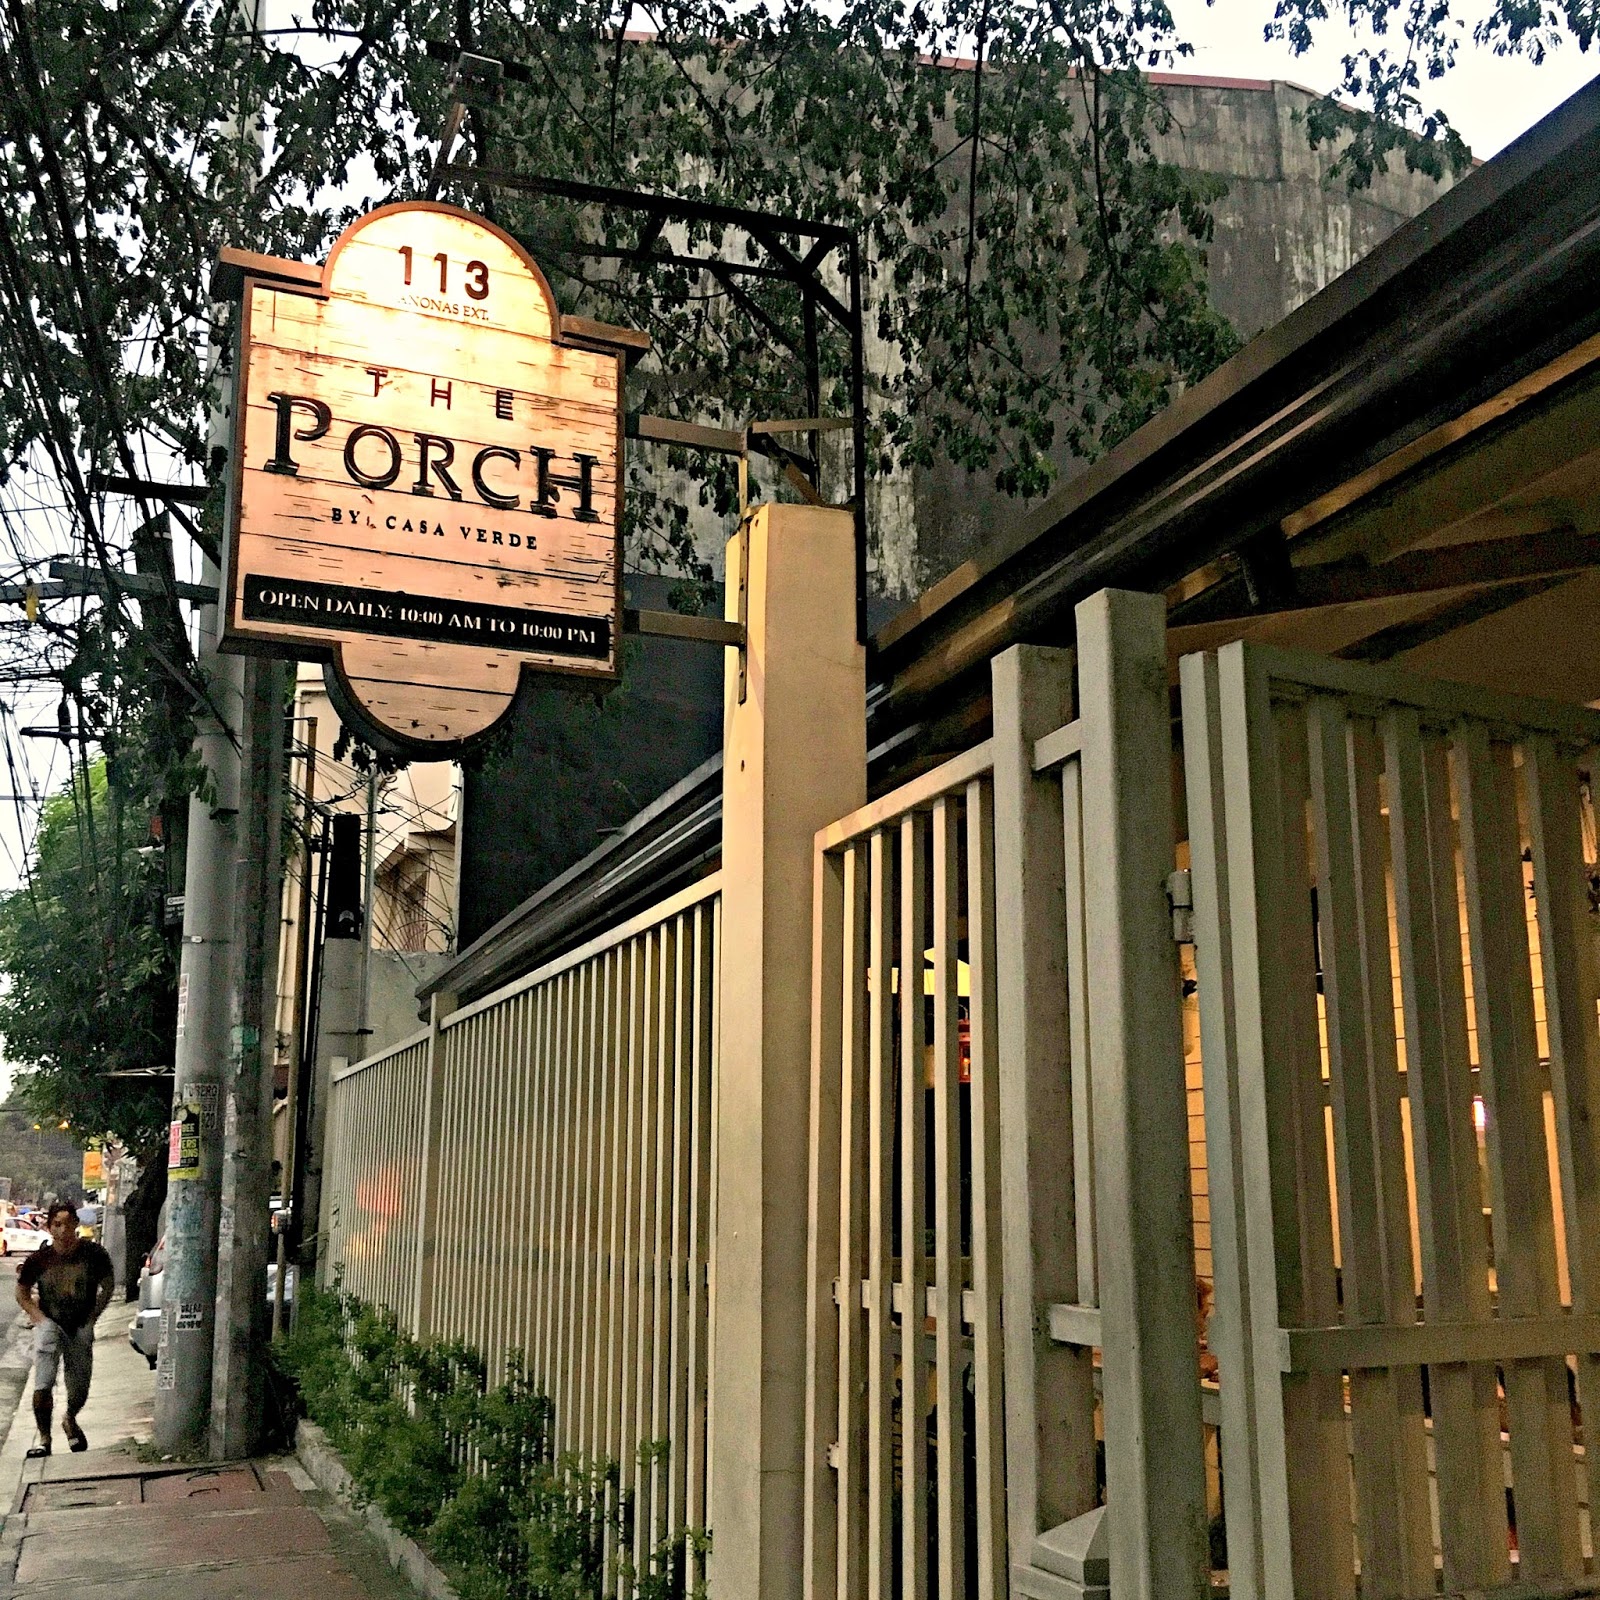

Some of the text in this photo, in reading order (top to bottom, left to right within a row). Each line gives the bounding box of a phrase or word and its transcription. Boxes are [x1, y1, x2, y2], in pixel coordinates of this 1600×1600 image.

[398, 245, 489, 300] 113
[463, 305, 489, 321] EXT.
[365, 367, 514, 421] THE
[263, 390, 601, 523] PORCH
[331, 507, 537, 550] BY CASA VERDE
[259, 590, 596, 644] OPEN DAILY: 10:00 AM TO 10:00 PM
